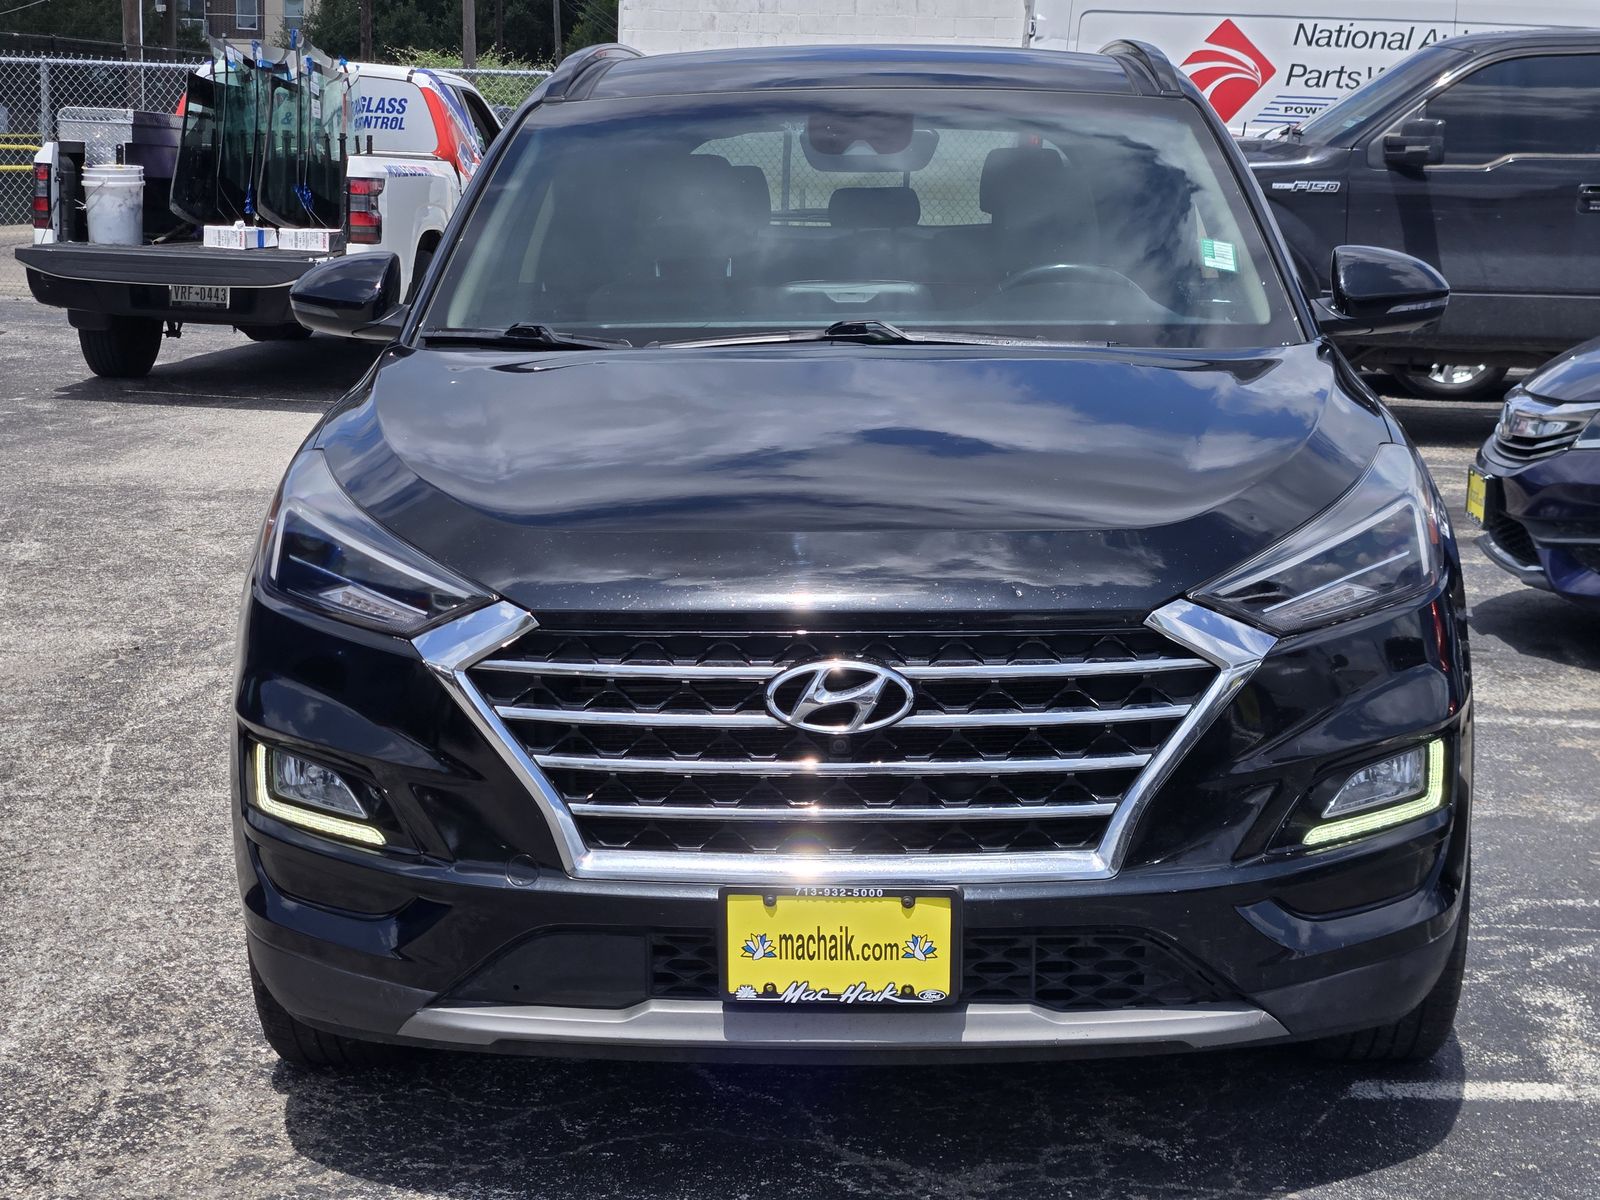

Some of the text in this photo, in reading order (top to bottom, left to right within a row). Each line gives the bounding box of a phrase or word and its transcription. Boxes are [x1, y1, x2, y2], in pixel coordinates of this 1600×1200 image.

[1293, 23, 1415, 51] National
[1285, 63, 1362, 89] Parts
[1284, 105, 1321, 115] POW
[355, 115, 405, 130] ONTROL
[794, 887, 884, 898] 713-932-5000
[778, 925, 900, 961] machaik.com
[779, 981, 838, 1003] Mac
[840, 981, 898, 1004] Haik
